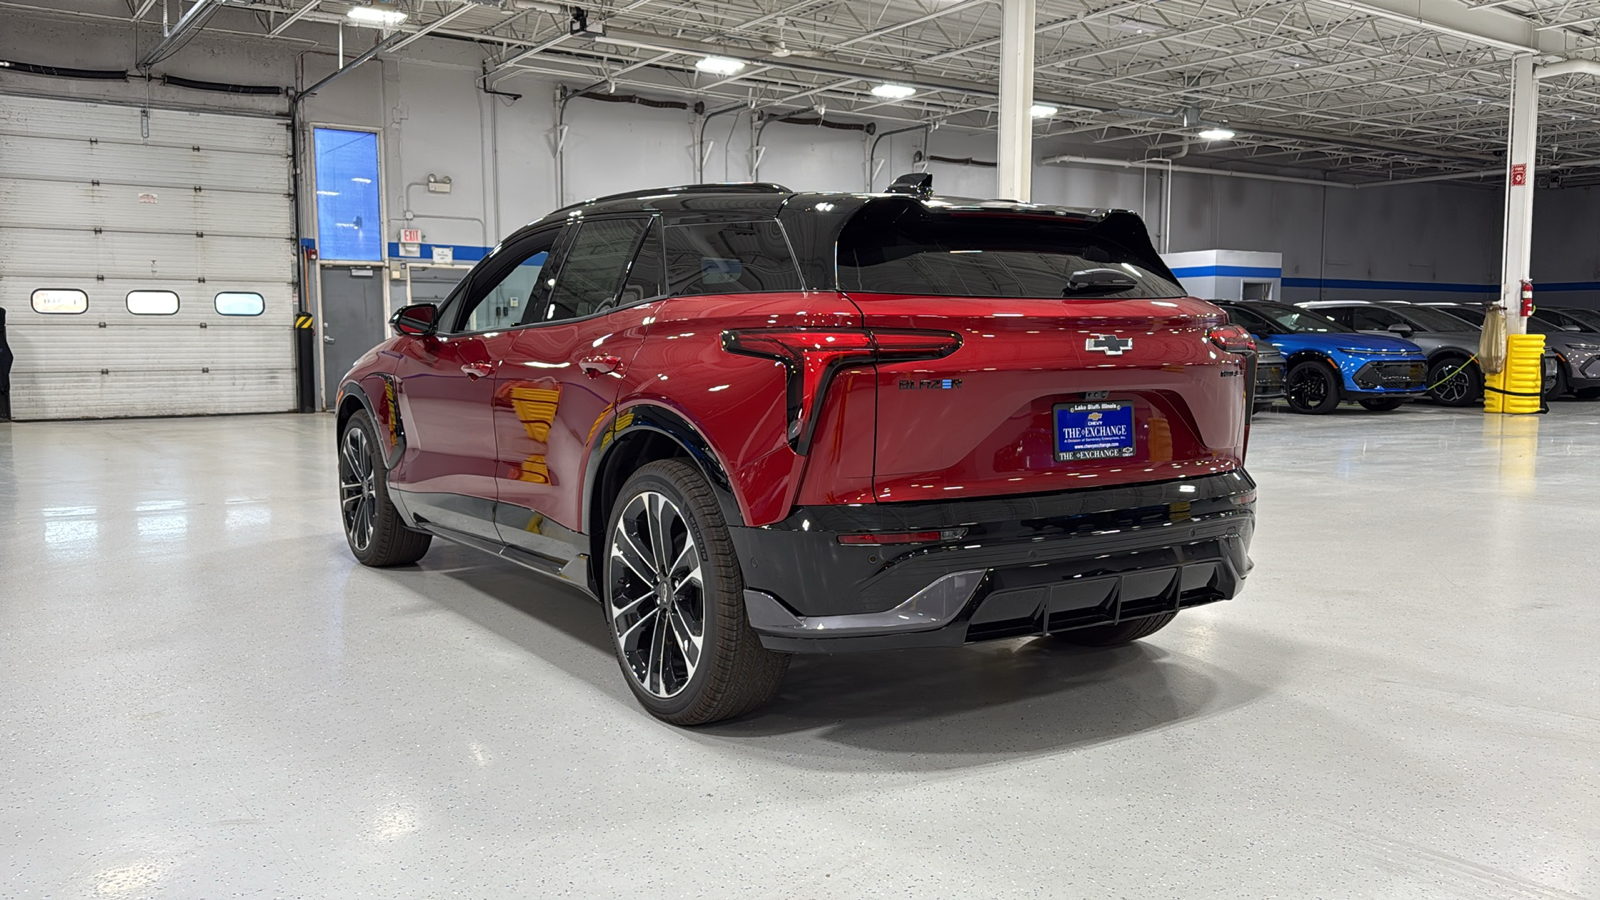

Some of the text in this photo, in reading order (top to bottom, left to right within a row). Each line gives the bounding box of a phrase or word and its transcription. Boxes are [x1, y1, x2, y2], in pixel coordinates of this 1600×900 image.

[404, 230, 419, 241] EXIT
[899, 379, 962, 390] BLAZER
[1063, 425, 1126, 439] THE EXCHANGE
[1059, 448, 1119, 460] THE EXCHANGE
[689, 516, 707, 560] MICHELIN
